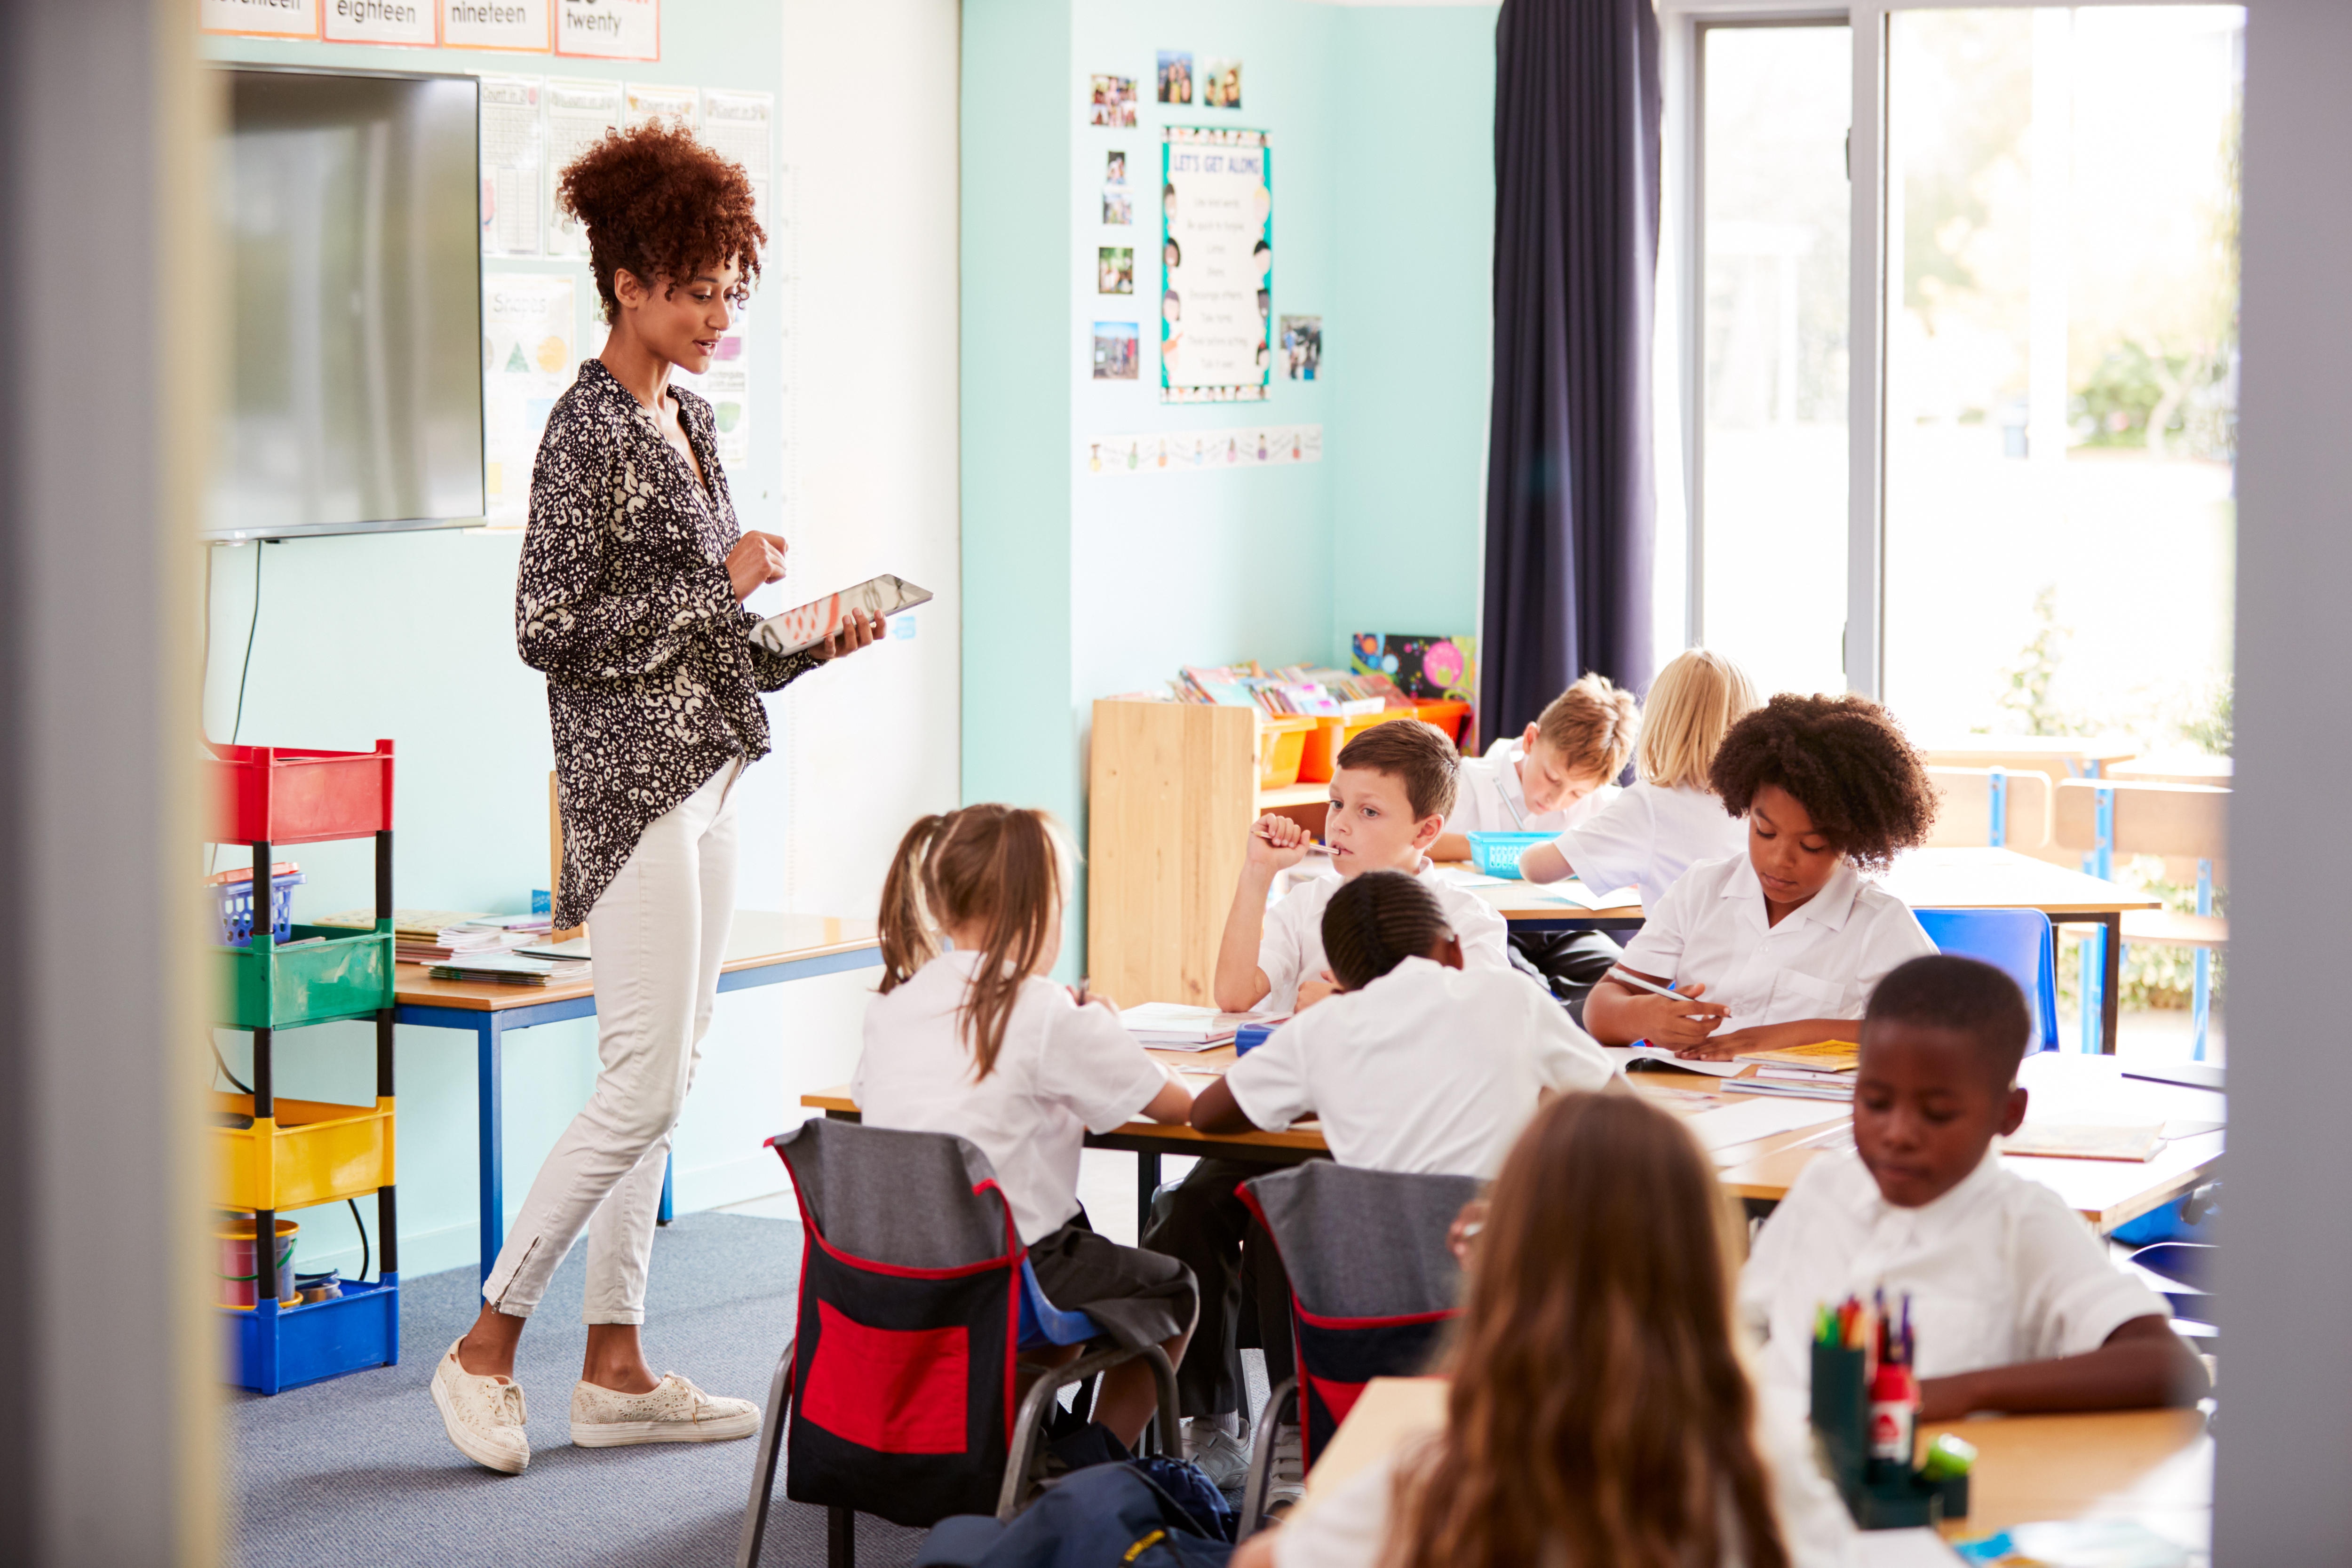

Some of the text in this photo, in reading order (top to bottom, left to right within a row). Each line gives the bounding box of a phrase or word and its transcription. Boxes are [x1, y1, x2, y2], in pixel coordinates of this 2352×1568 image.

[337, 0, 416, 23] eighteen
[452, 0, 526, 23] nineteen
[567, 8, 621, 38] twenty
[1204, 155, 1224, 173] GET
[1228, 157, 1260, 174] ALONG
